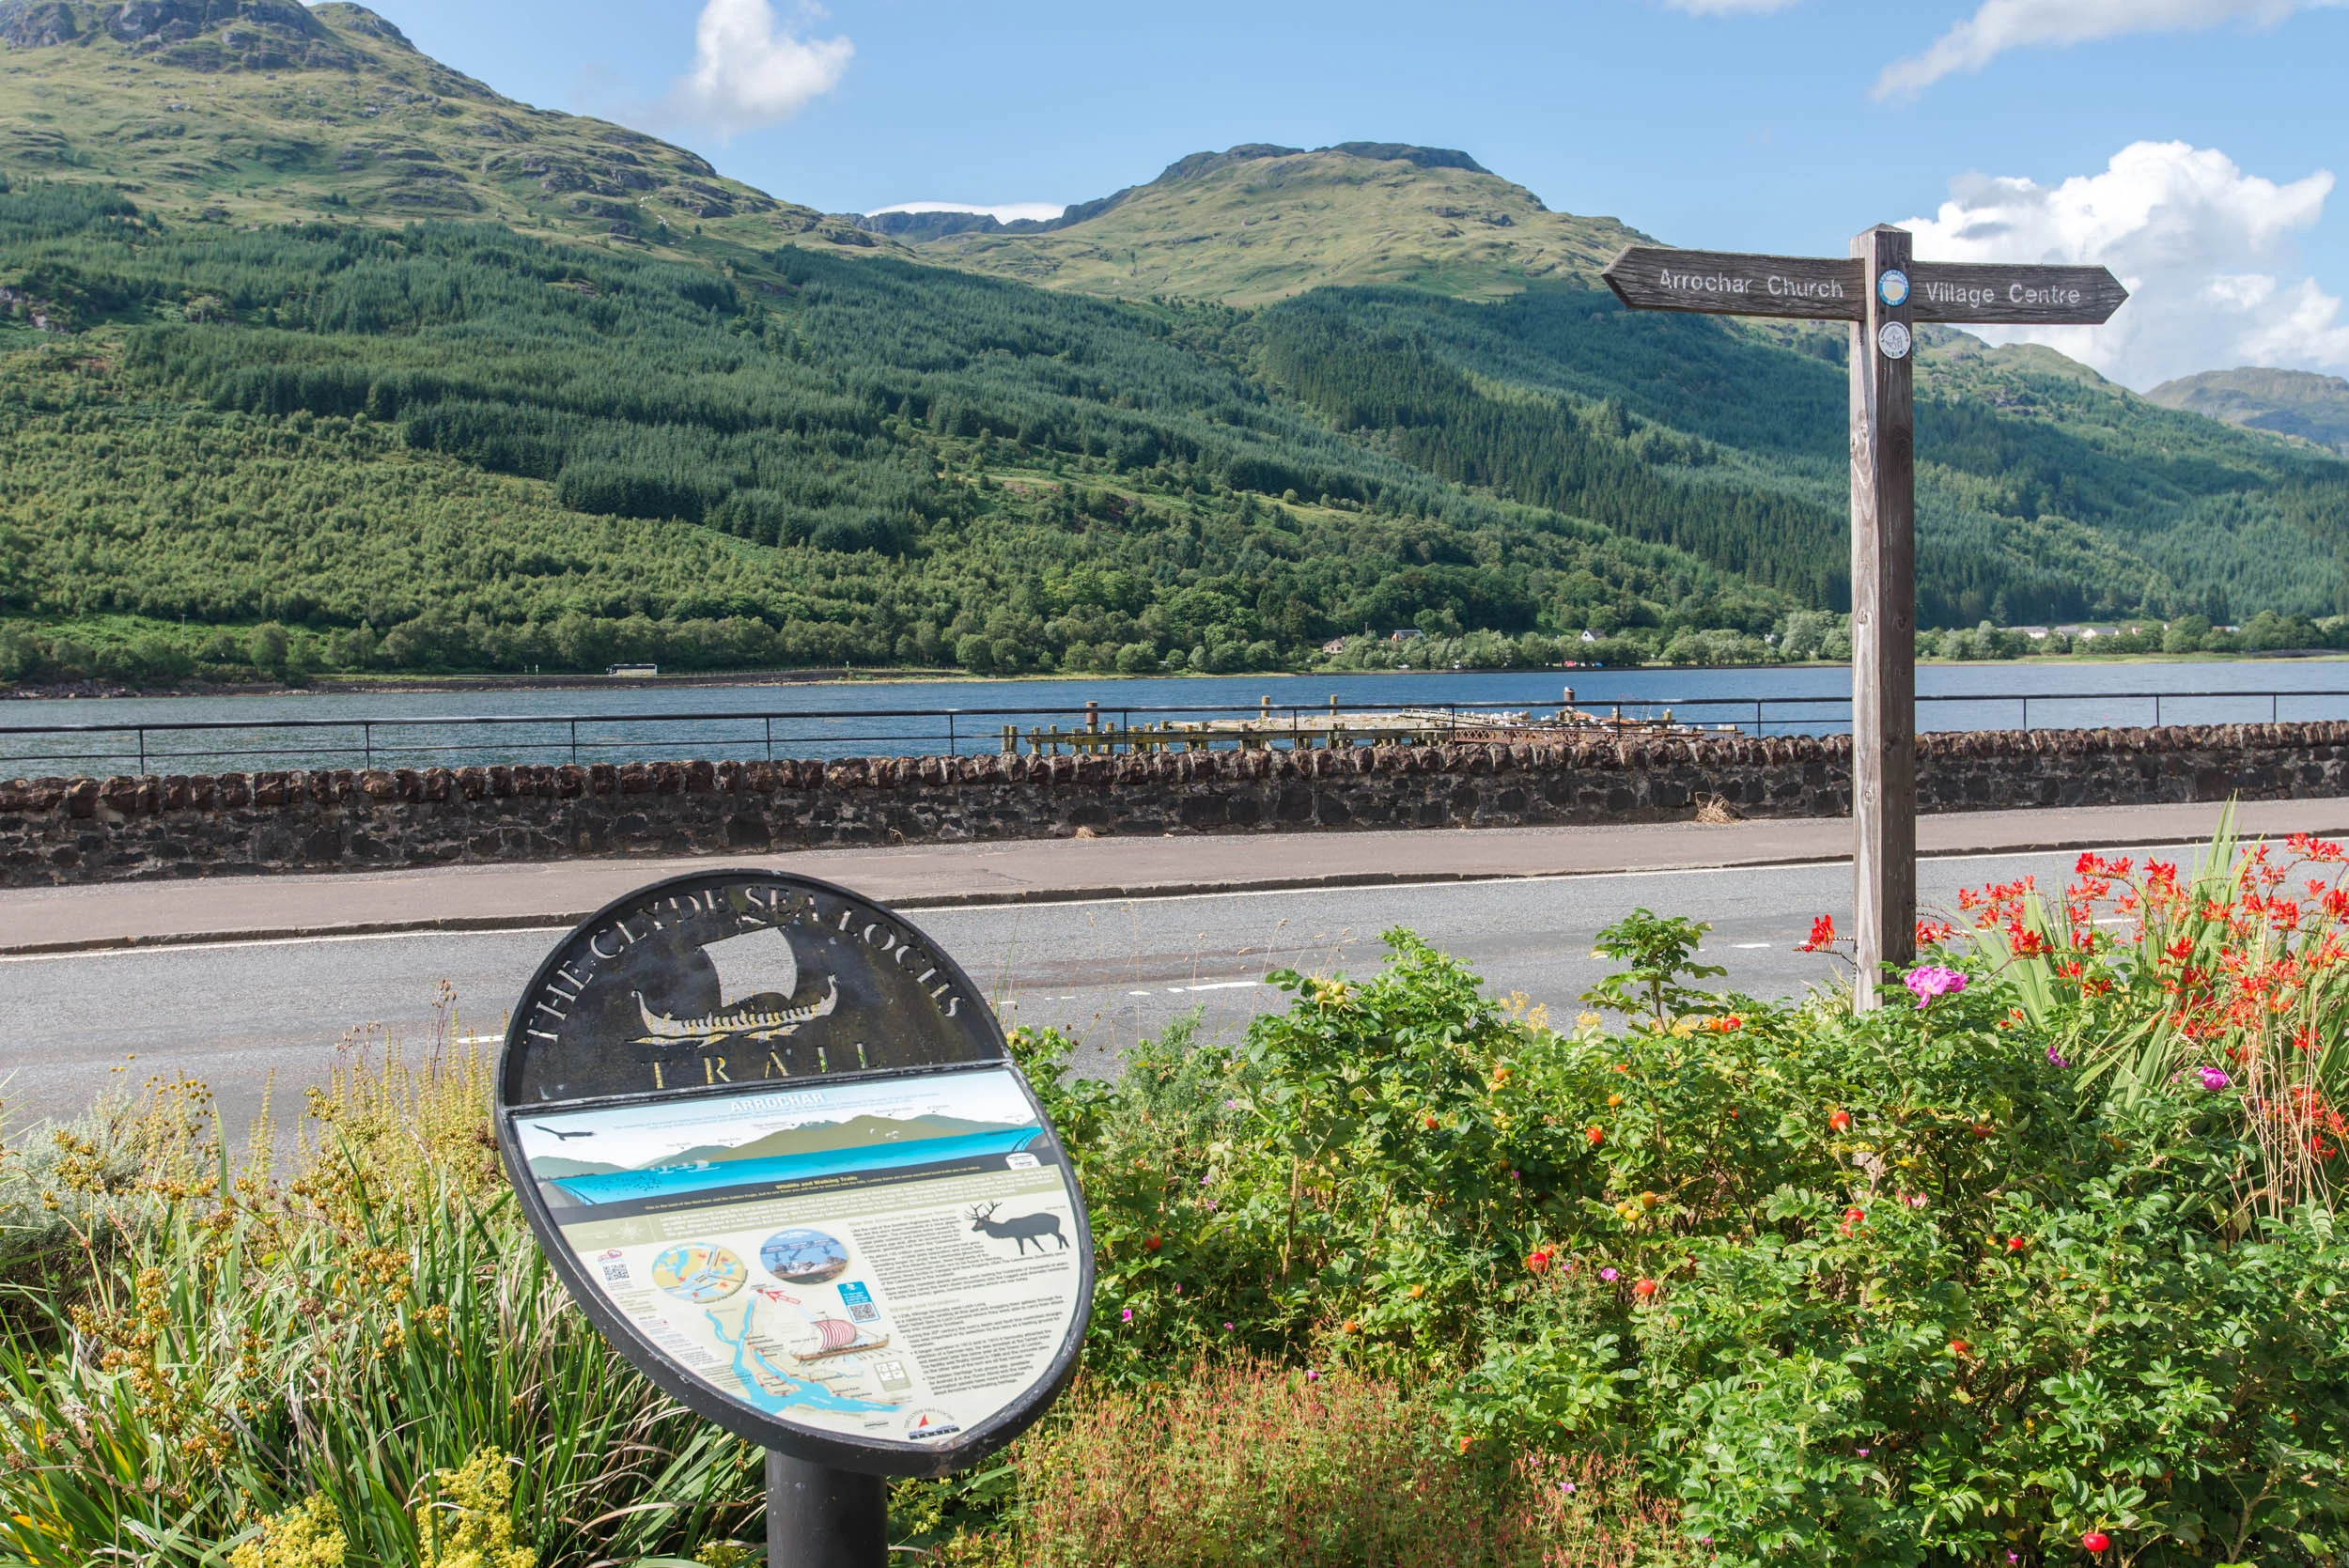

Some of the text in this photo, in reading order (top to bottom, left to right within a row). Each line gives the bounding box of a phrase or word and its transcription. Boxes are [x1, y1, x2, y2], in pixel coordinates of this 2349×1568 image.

[1659, 269, 1843, 299] Arrochar Church
[1925, 282, 2081, 309] Village Centre
[527, 886, 967, 1045] THE CLYDE SEA LOCHS
[644, 1042, 882, 1090] TRAIL
[730, 1092, 826, 1113] ARROCHAR
